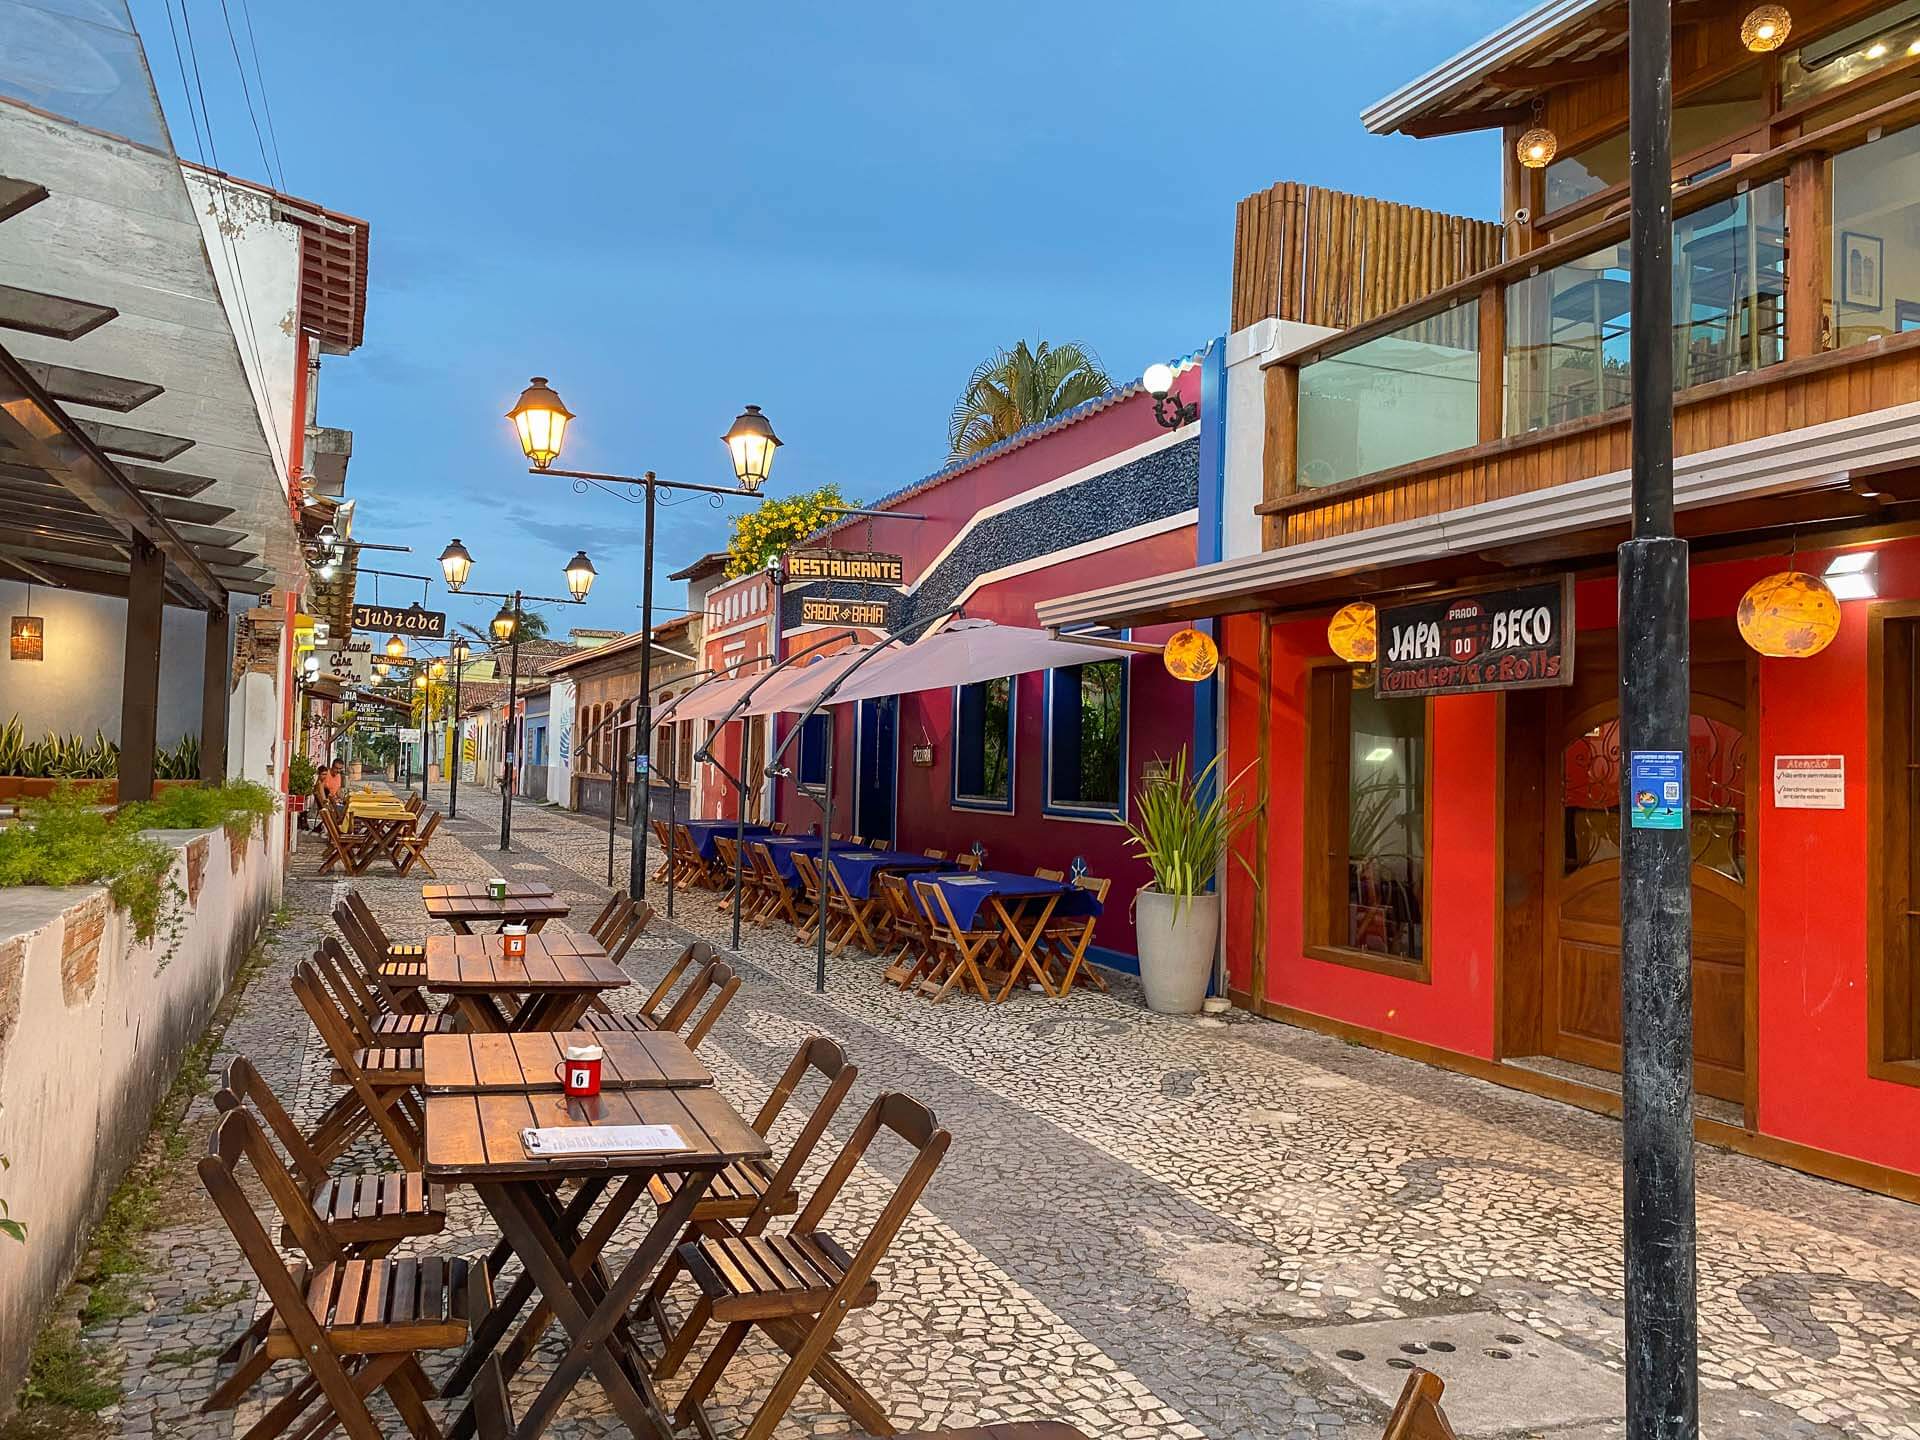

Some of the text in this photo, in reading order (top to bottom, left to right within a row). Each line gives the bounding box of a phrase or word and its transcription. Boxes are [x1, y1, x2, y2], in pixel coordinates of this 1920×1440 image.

[789, 558, 901, 579] RESTAURANTE
[354, 607, 440, 631] Jubiabá
[803, 603, 839, 621] SABOR
[1449, 606, 1478, 621] PRADO
[1387, 606, 1551, 662] JAPA DO BECO
[1381, 649, 1561, 690] Temakeria e Rolls
[513, 942, 519, 950] 7
[576, 1072, 584, 1086] 6
